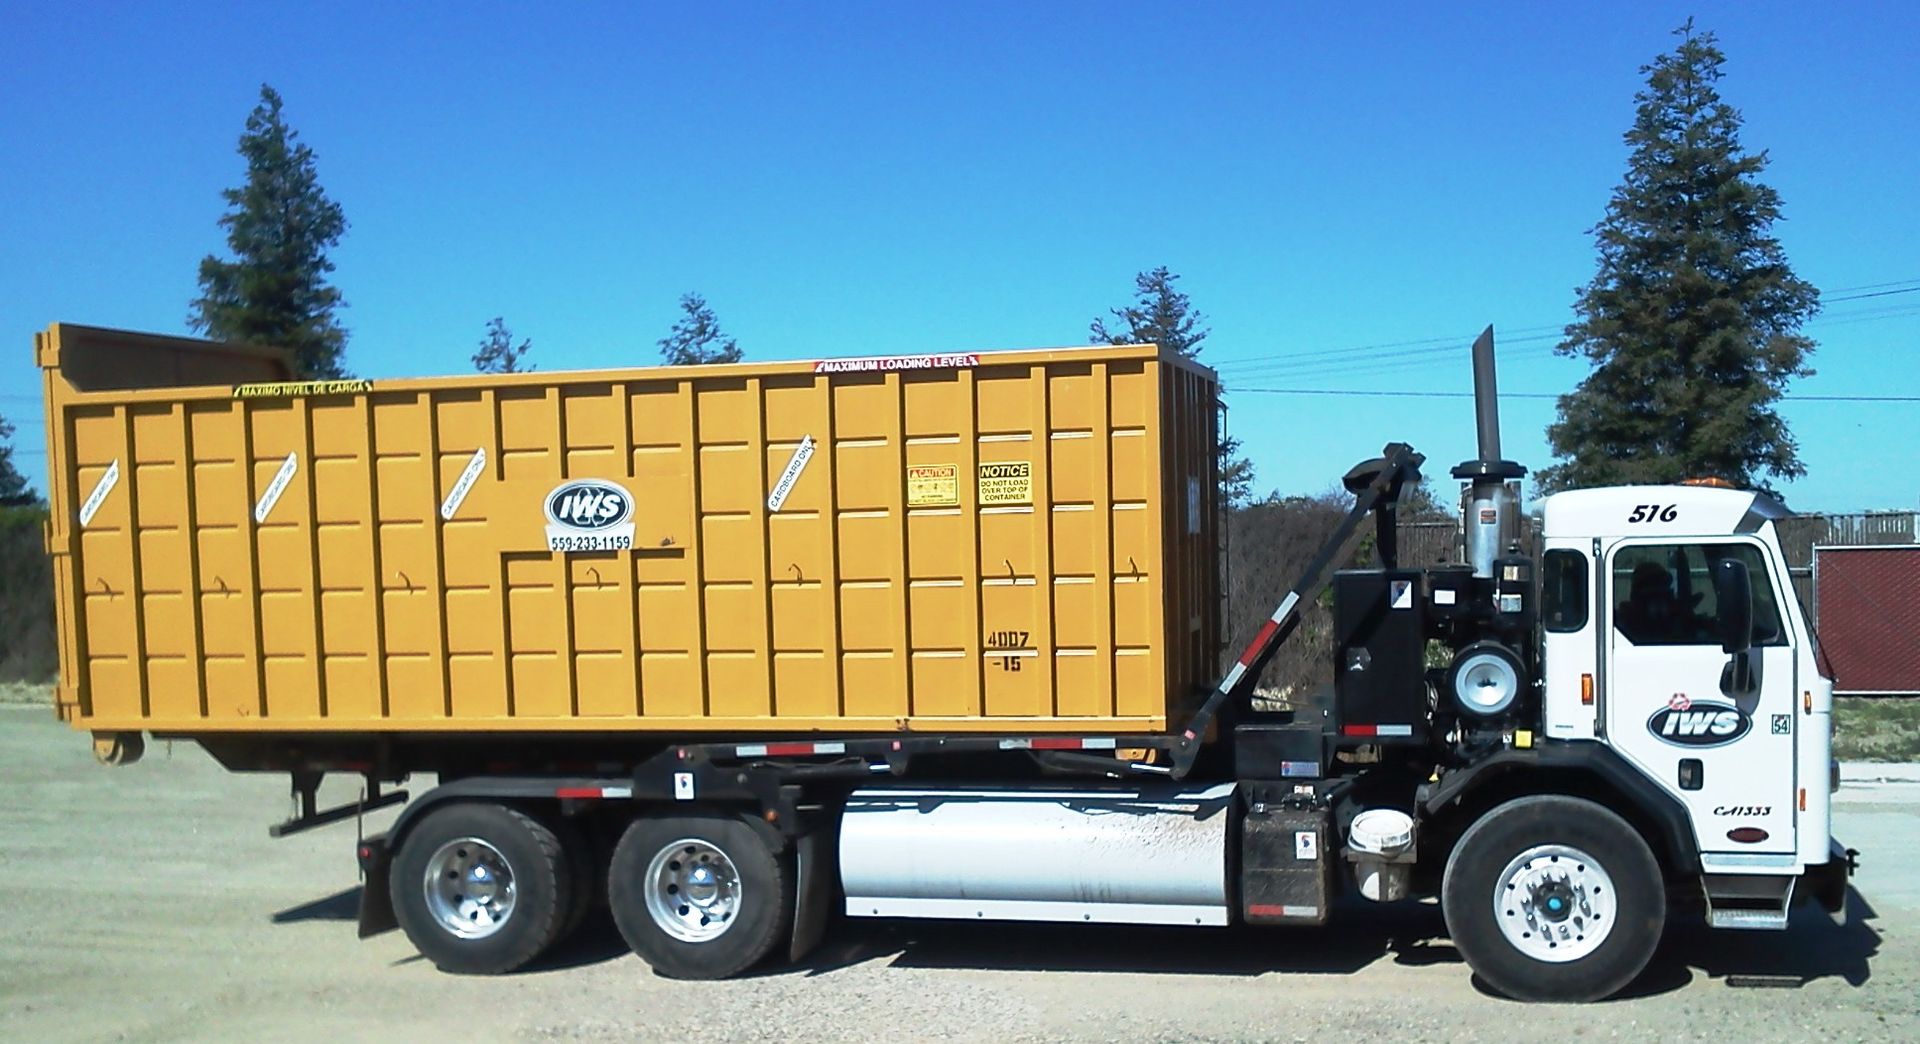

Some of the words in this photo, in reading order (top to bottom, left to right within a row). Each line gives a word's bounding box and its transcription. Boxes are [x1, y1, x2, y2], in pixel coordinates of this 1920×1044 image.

[824, 361, 878, 373] MAXIMUM
[880, 358, 931, 370] LOADING
[934, 356, 970, 368] LEVEL
[241, 386, 281, 397] MAXIMO
[282, 384, 311, 396] NIVEL
[313, 384, 326, 395] DE
[328, 382, 364, 394] CARGA
[918, 468, 952, 478] CAUTION
[981, 465, 1029, 478] NOTICE
[770, 459, 802, 508] CARDBOARD
[1009, 479, 1029, 487] LOAD
[559, 493, 621, 519] IWS
[1628, 504, 1678, 523] 516
[551, 536, 630, 550] 559-233-1159
[988, 631, 1029, 647] 4007
[992, 656, 1021, 672] -15
[1662, 711, 1740, 736] IWS
[1774, 719, 1788, 733] 54
